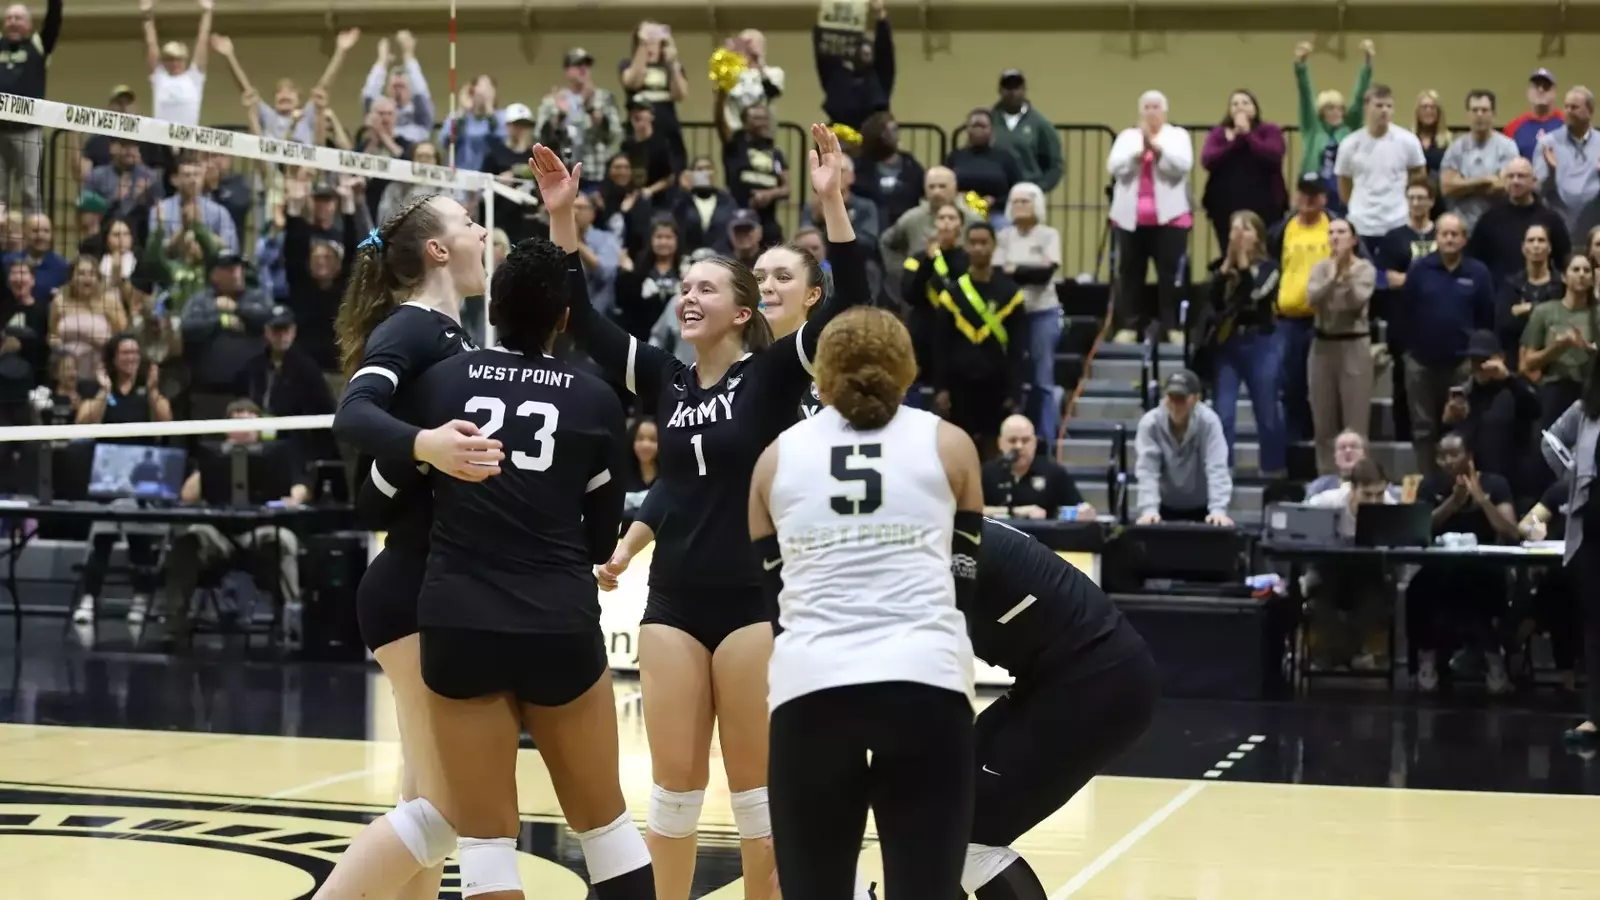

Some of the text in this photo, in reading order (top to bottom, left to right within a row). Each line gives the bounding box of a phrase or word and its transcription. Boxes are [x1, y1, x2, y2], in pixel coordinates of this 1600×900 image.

[11, 96, 35, 116] POINT
[75, 106, 141, 133] ARMY WEST POINT
[468, 364, 574, 388] WEST POINT
[667, 391, 735, 428] ARMY
[464, 396, 560, 472] 23
[690, 434, 707, 476] 1
[830, 443, 882, 515] 5
